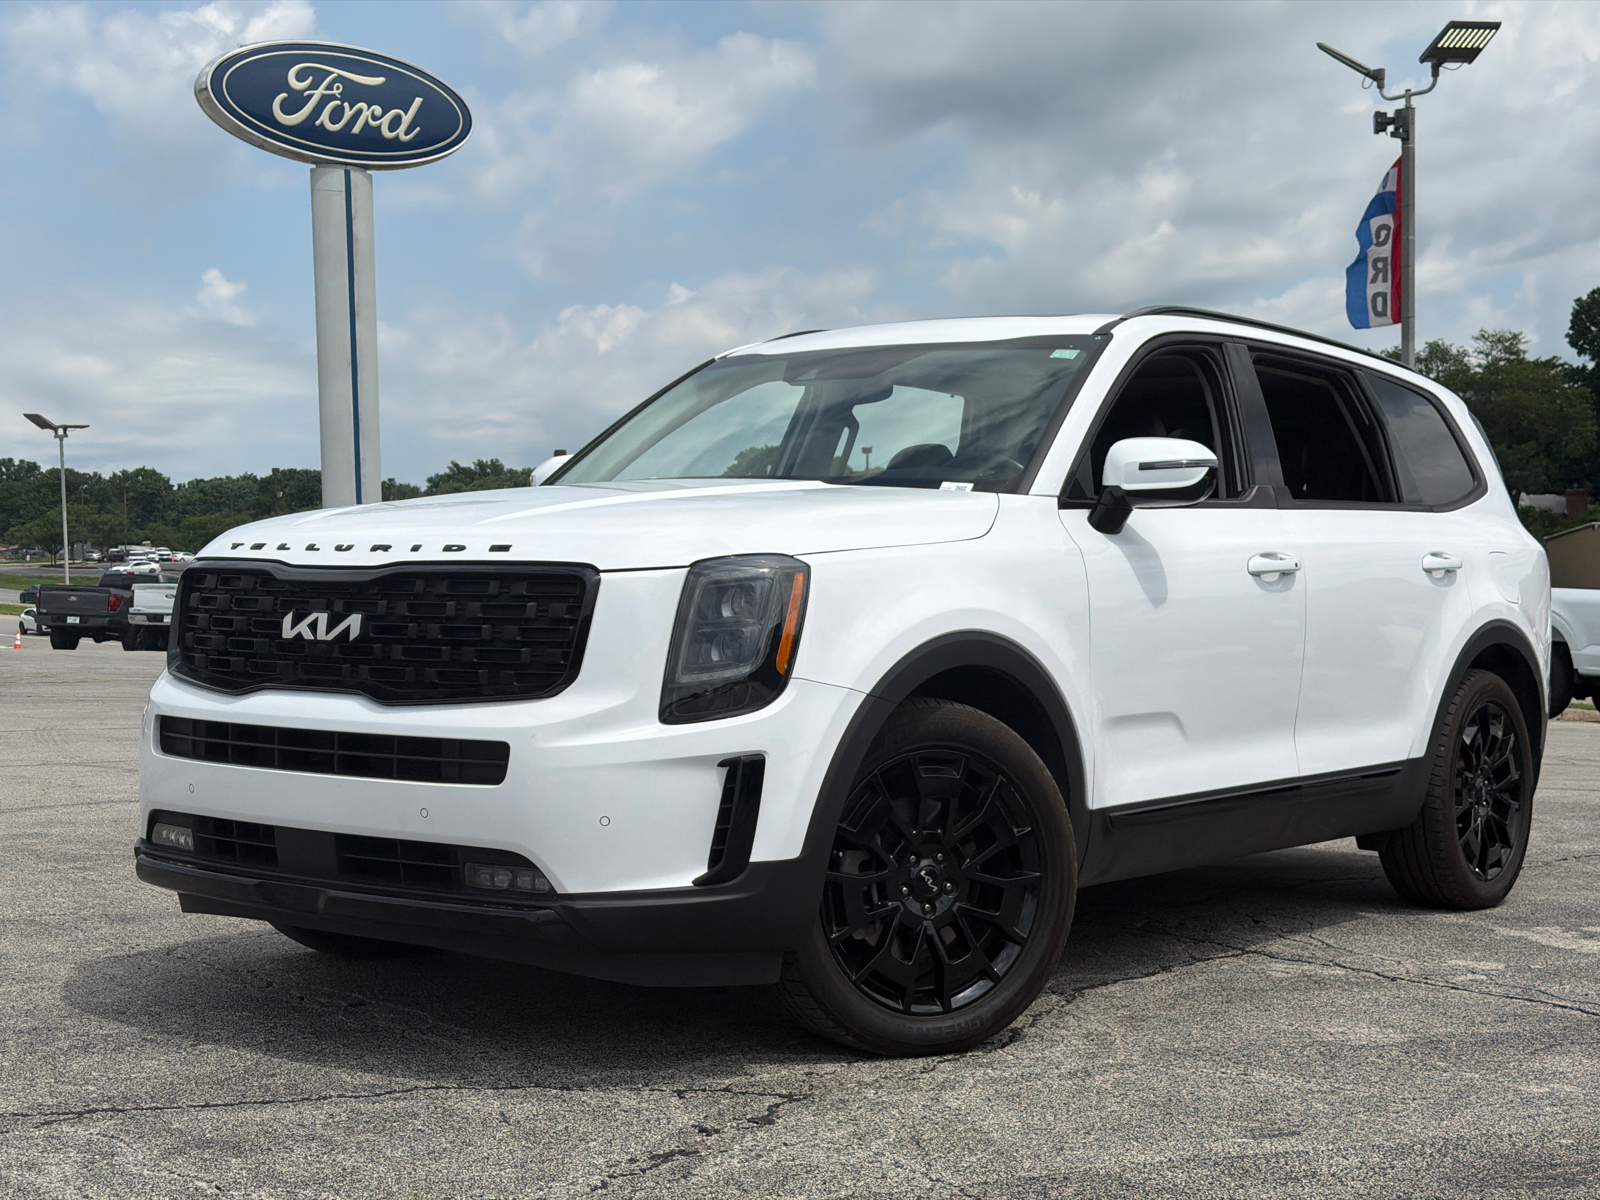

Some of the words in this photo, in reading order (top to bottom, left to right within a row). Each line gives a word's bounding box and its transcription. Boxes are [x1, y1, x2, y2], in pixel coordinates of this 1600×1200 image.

[272, 62, 424, 143] Ford
[230, 542, 513, 553] TELLURIDE
[281, 609, 363, 642] KIA
